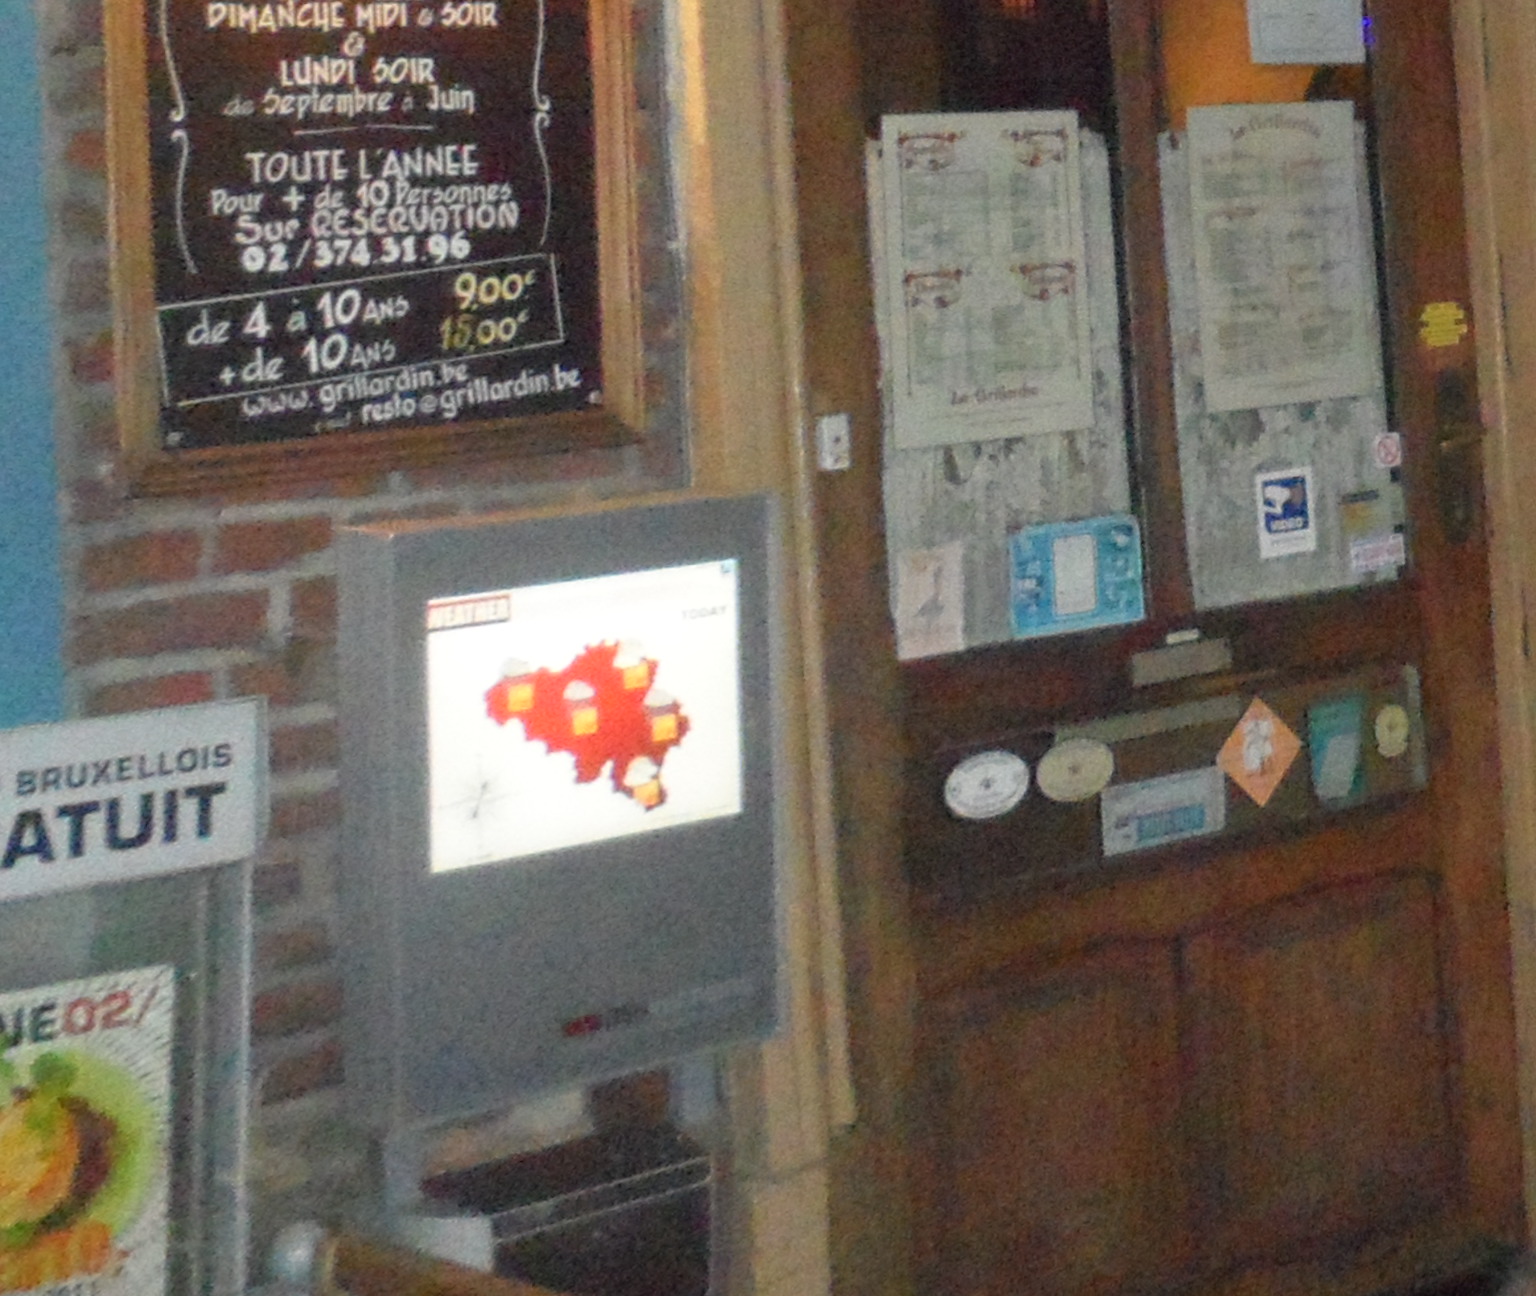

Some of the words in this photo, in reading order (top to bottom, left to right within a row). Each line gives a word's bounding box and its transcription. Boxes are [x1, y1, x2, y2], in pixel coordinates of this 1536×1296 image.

[207, 2, 346, 33] DIMANCHE
[356, 3, 408, 33] MIDI
[441, 1, 498, 28] SOIR
[343, 31, 367, 57] &
[280, 56, 357, 86] LUNDI
[373, 57, 436, 85] SOIR
[262, 88, 392, 120] Septembre
[428, 84, 476, 114] Juin
[245, 148, 350, 183] TOUTE
[359, 144, 480, 181] L'ANNEE
[210, 188, 265, 217] Pour
[281, 186, 307, 212] +
[314, 186, 344, 211] de
[356, 180, 390, 207] 10
[396, 177, 513, 206] Personnes
[234, 215, 300, 246] Sur
[311, 203, 521, 236] RESERVATION
[240, 230, 471, 274] 02/374.31.96
[187, 309, 230, 347] de
[241, 301, 273, 340] 4
[315, 288, 363, 330] 10
[361, 293, 411, 326] ANS
[241, 347, 286, 385] de
[302, 333, 350, 375] 10
[350, 338, 397, 371] ANS
[241, 362, 470, 419] www.grillardin.be
[360, 363, 582, 425] resto@grillardin.be
[15, 741, 233, 797] BRUXELLOIS
